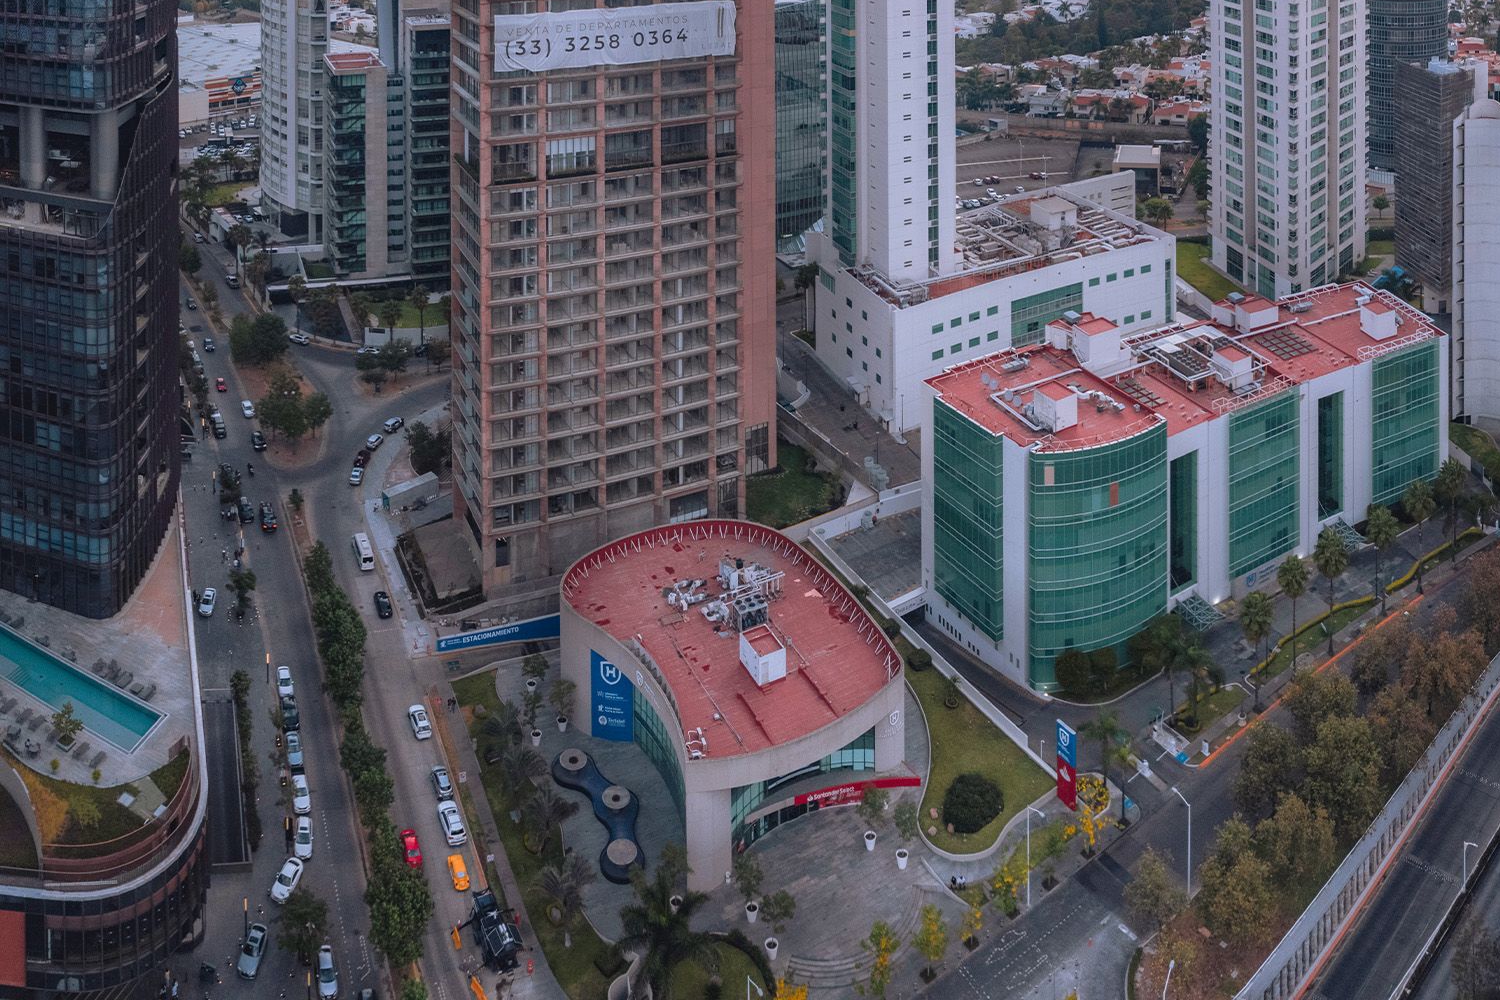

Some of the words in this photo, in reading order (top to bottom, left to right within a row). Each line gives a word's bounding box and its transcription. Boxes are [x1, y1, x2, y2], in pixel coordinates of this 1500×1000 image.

[507, 26, 549, 37] VENTA
[556, 23, 572, 34] DE
[579, 15, 689, 32] DEPARTAMENTOS
[505, 38, 551, 59] (33)
[565, 34, 621, 52] 3258
[633, 28, 688, 47] 0364
[462, 626, 520, 643] ESTACIONAMIENTO
[605, 665, 617, 678] H
